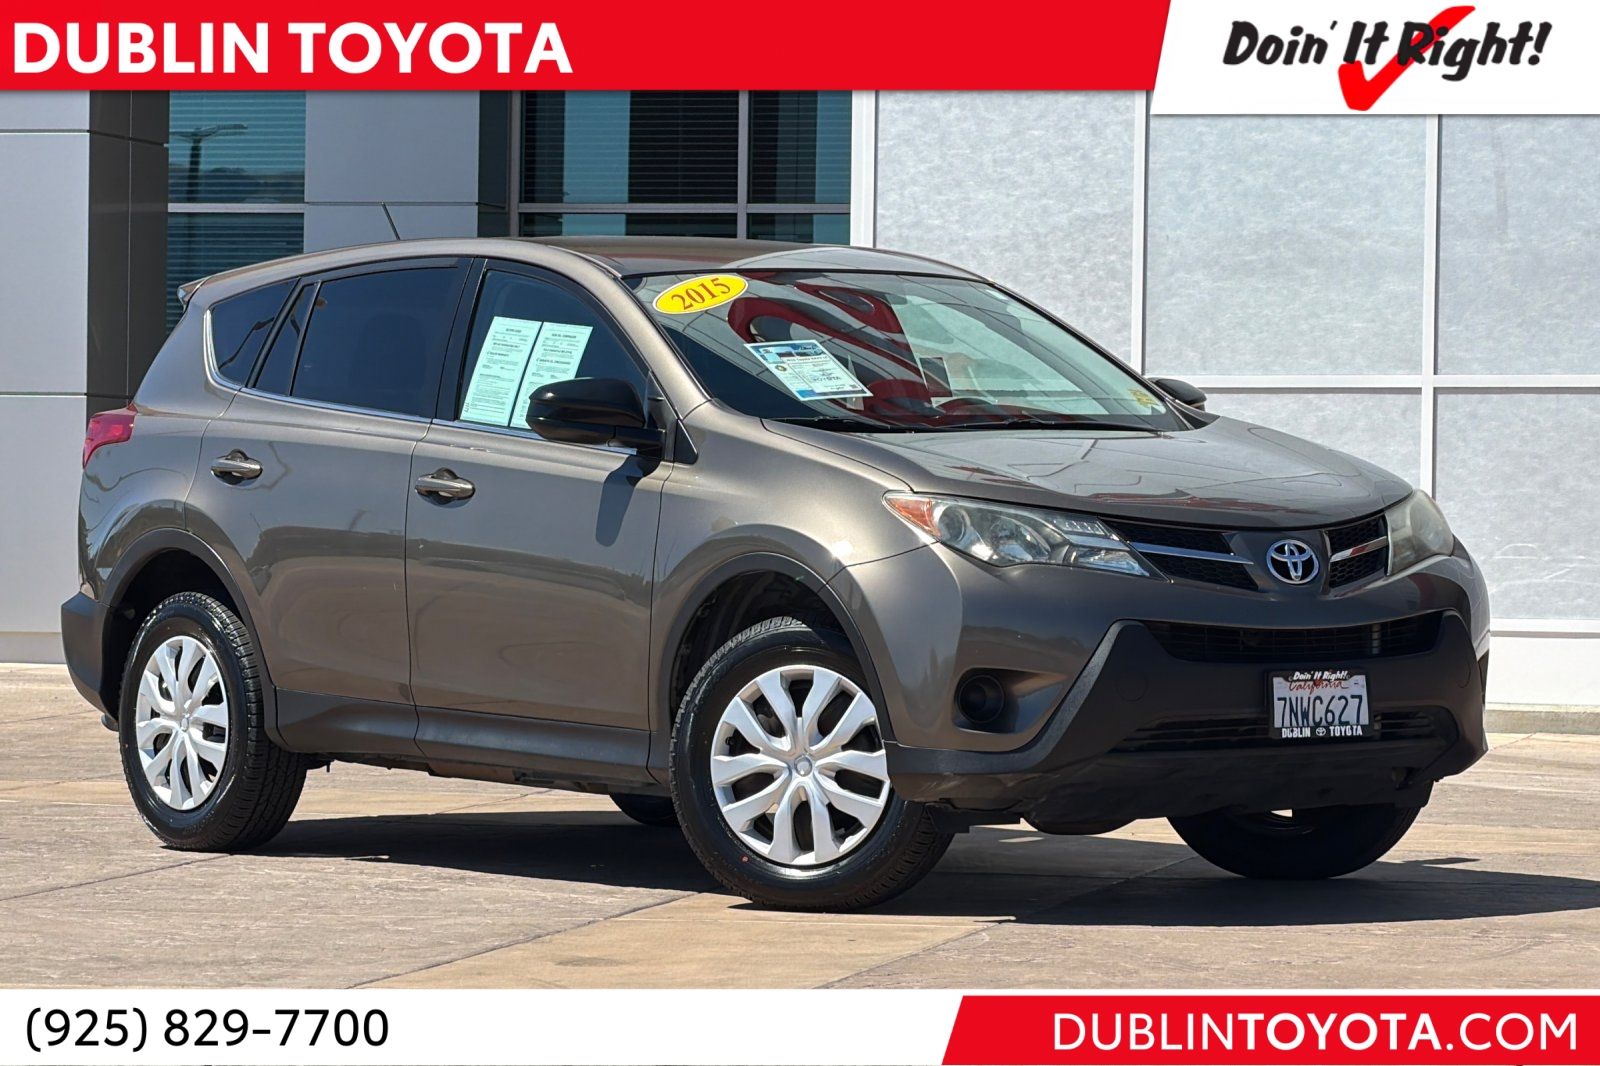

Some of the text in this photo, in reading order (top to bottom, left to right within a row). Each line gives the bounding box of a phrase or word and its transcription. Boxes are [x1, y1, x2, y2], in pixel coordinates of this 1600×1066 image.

[671, 278, 731, 310] 2015
[1277, 694, 1363, 727] 7NWC627
[1282, 725, 1363, 738] DUBLIN TOYOTA
